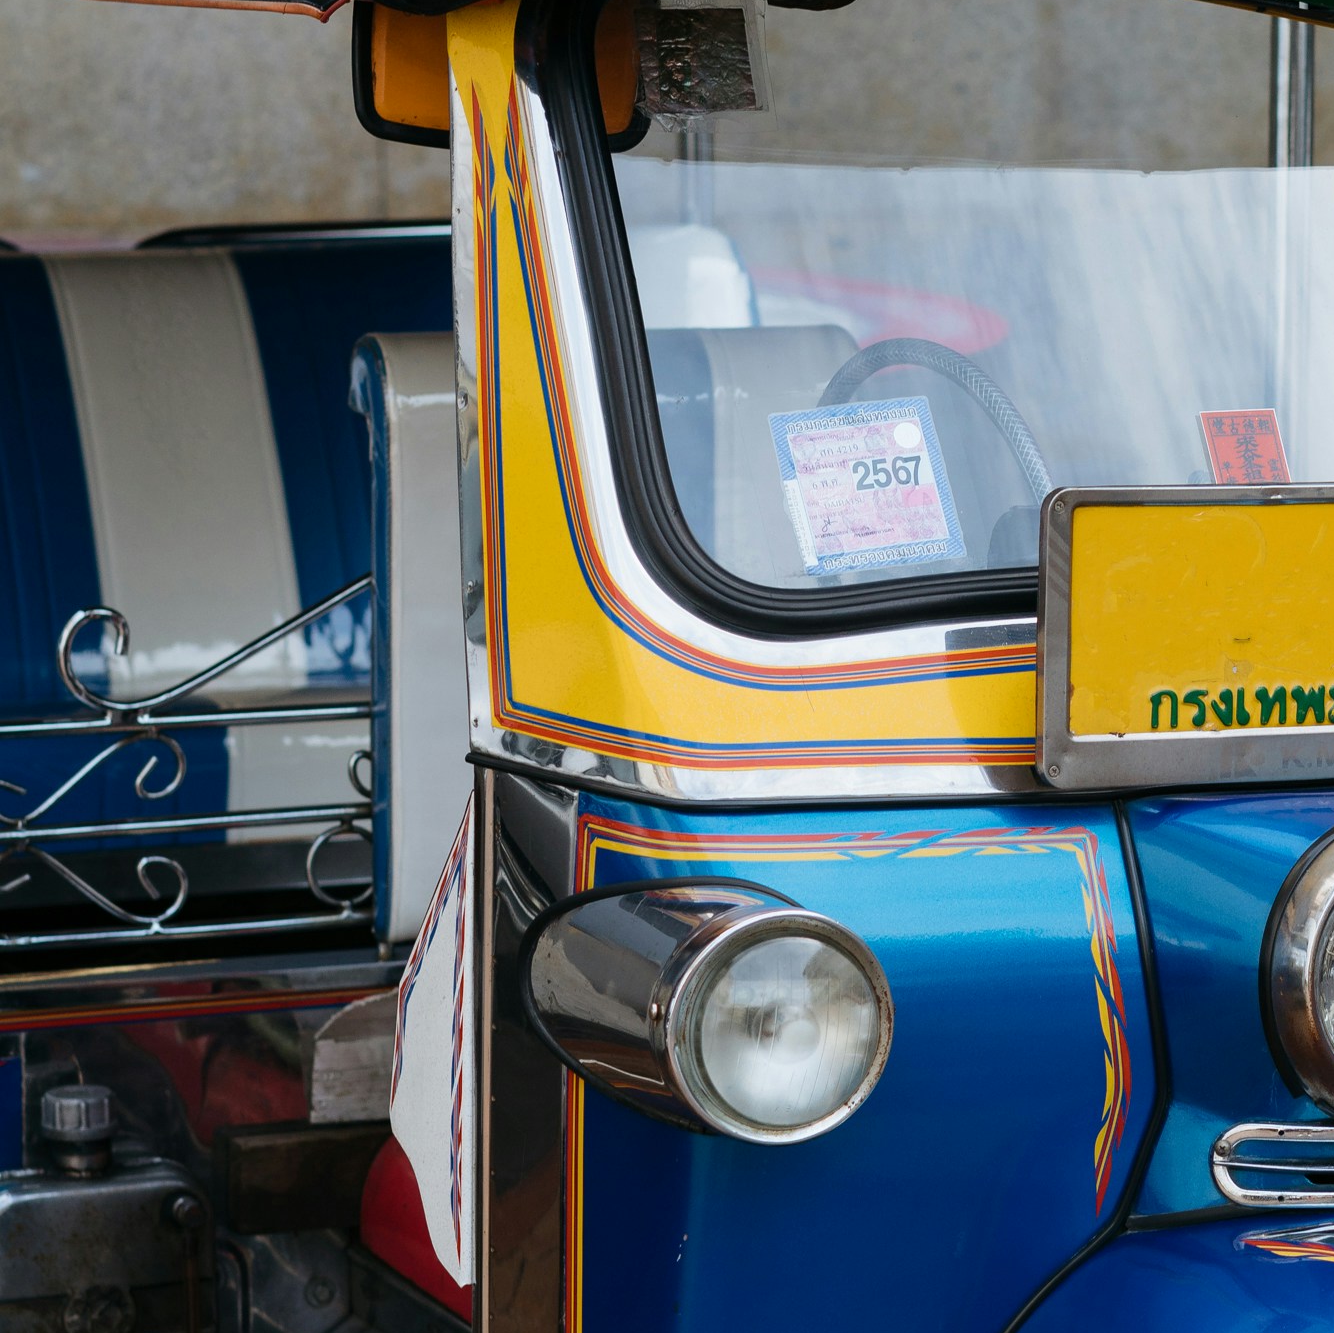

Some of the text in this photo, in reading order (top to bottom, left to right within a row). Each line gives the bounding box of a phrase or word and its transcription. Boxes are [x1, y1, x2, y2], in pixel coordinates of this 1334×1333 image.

[786, 406, 917, 434] กรมการขนส่งทางบก
[837, 443, 859, 454] 4219
[851, 455, 922, 491] 2567
[823, 542, 947, 569] กระทรวงคมนาคม
